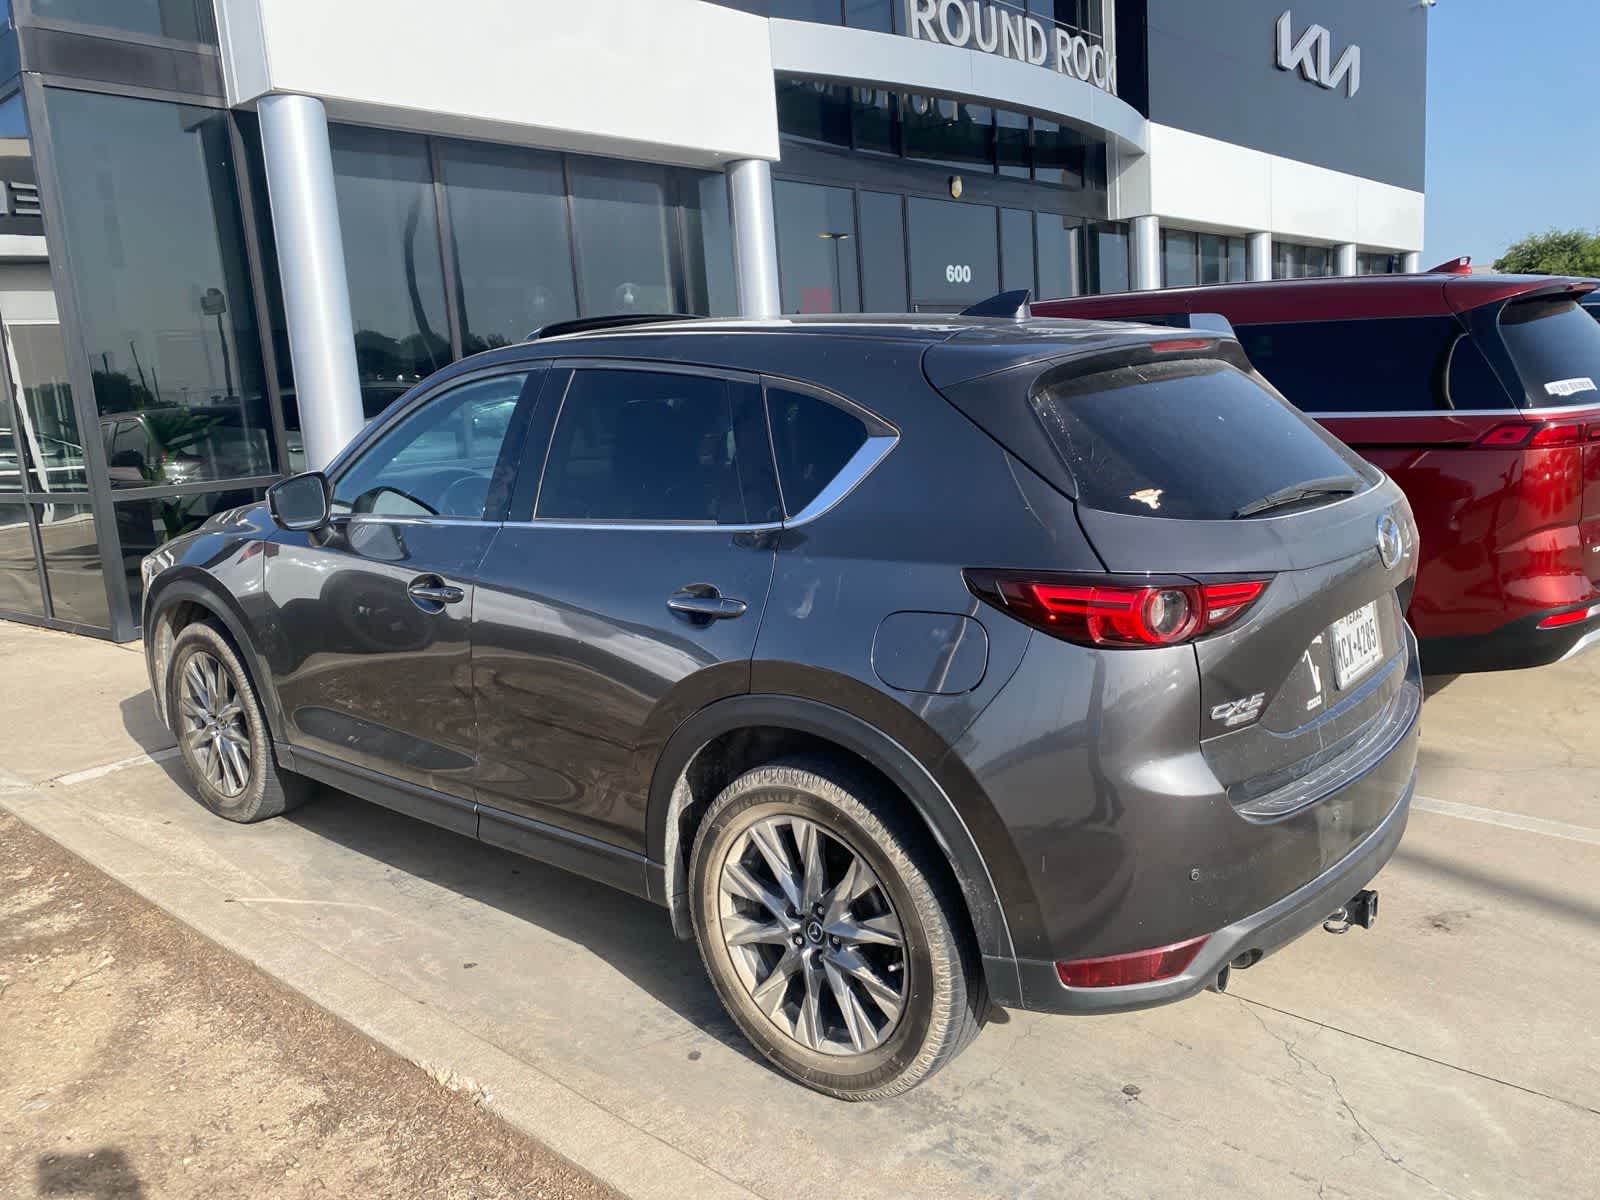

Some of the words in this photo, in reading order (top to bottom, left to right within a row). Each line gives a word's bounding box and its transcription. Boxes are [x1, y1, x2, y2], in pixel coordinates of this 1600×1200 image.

[908, 0, 1047, 66] ROUND
[1055, 28, 1118, 96] ROCK
[1276, 8, 1361, 98] KIA
[945, 264, 972, 283] 600
[1210, 691, 1265, 720] CX-5
